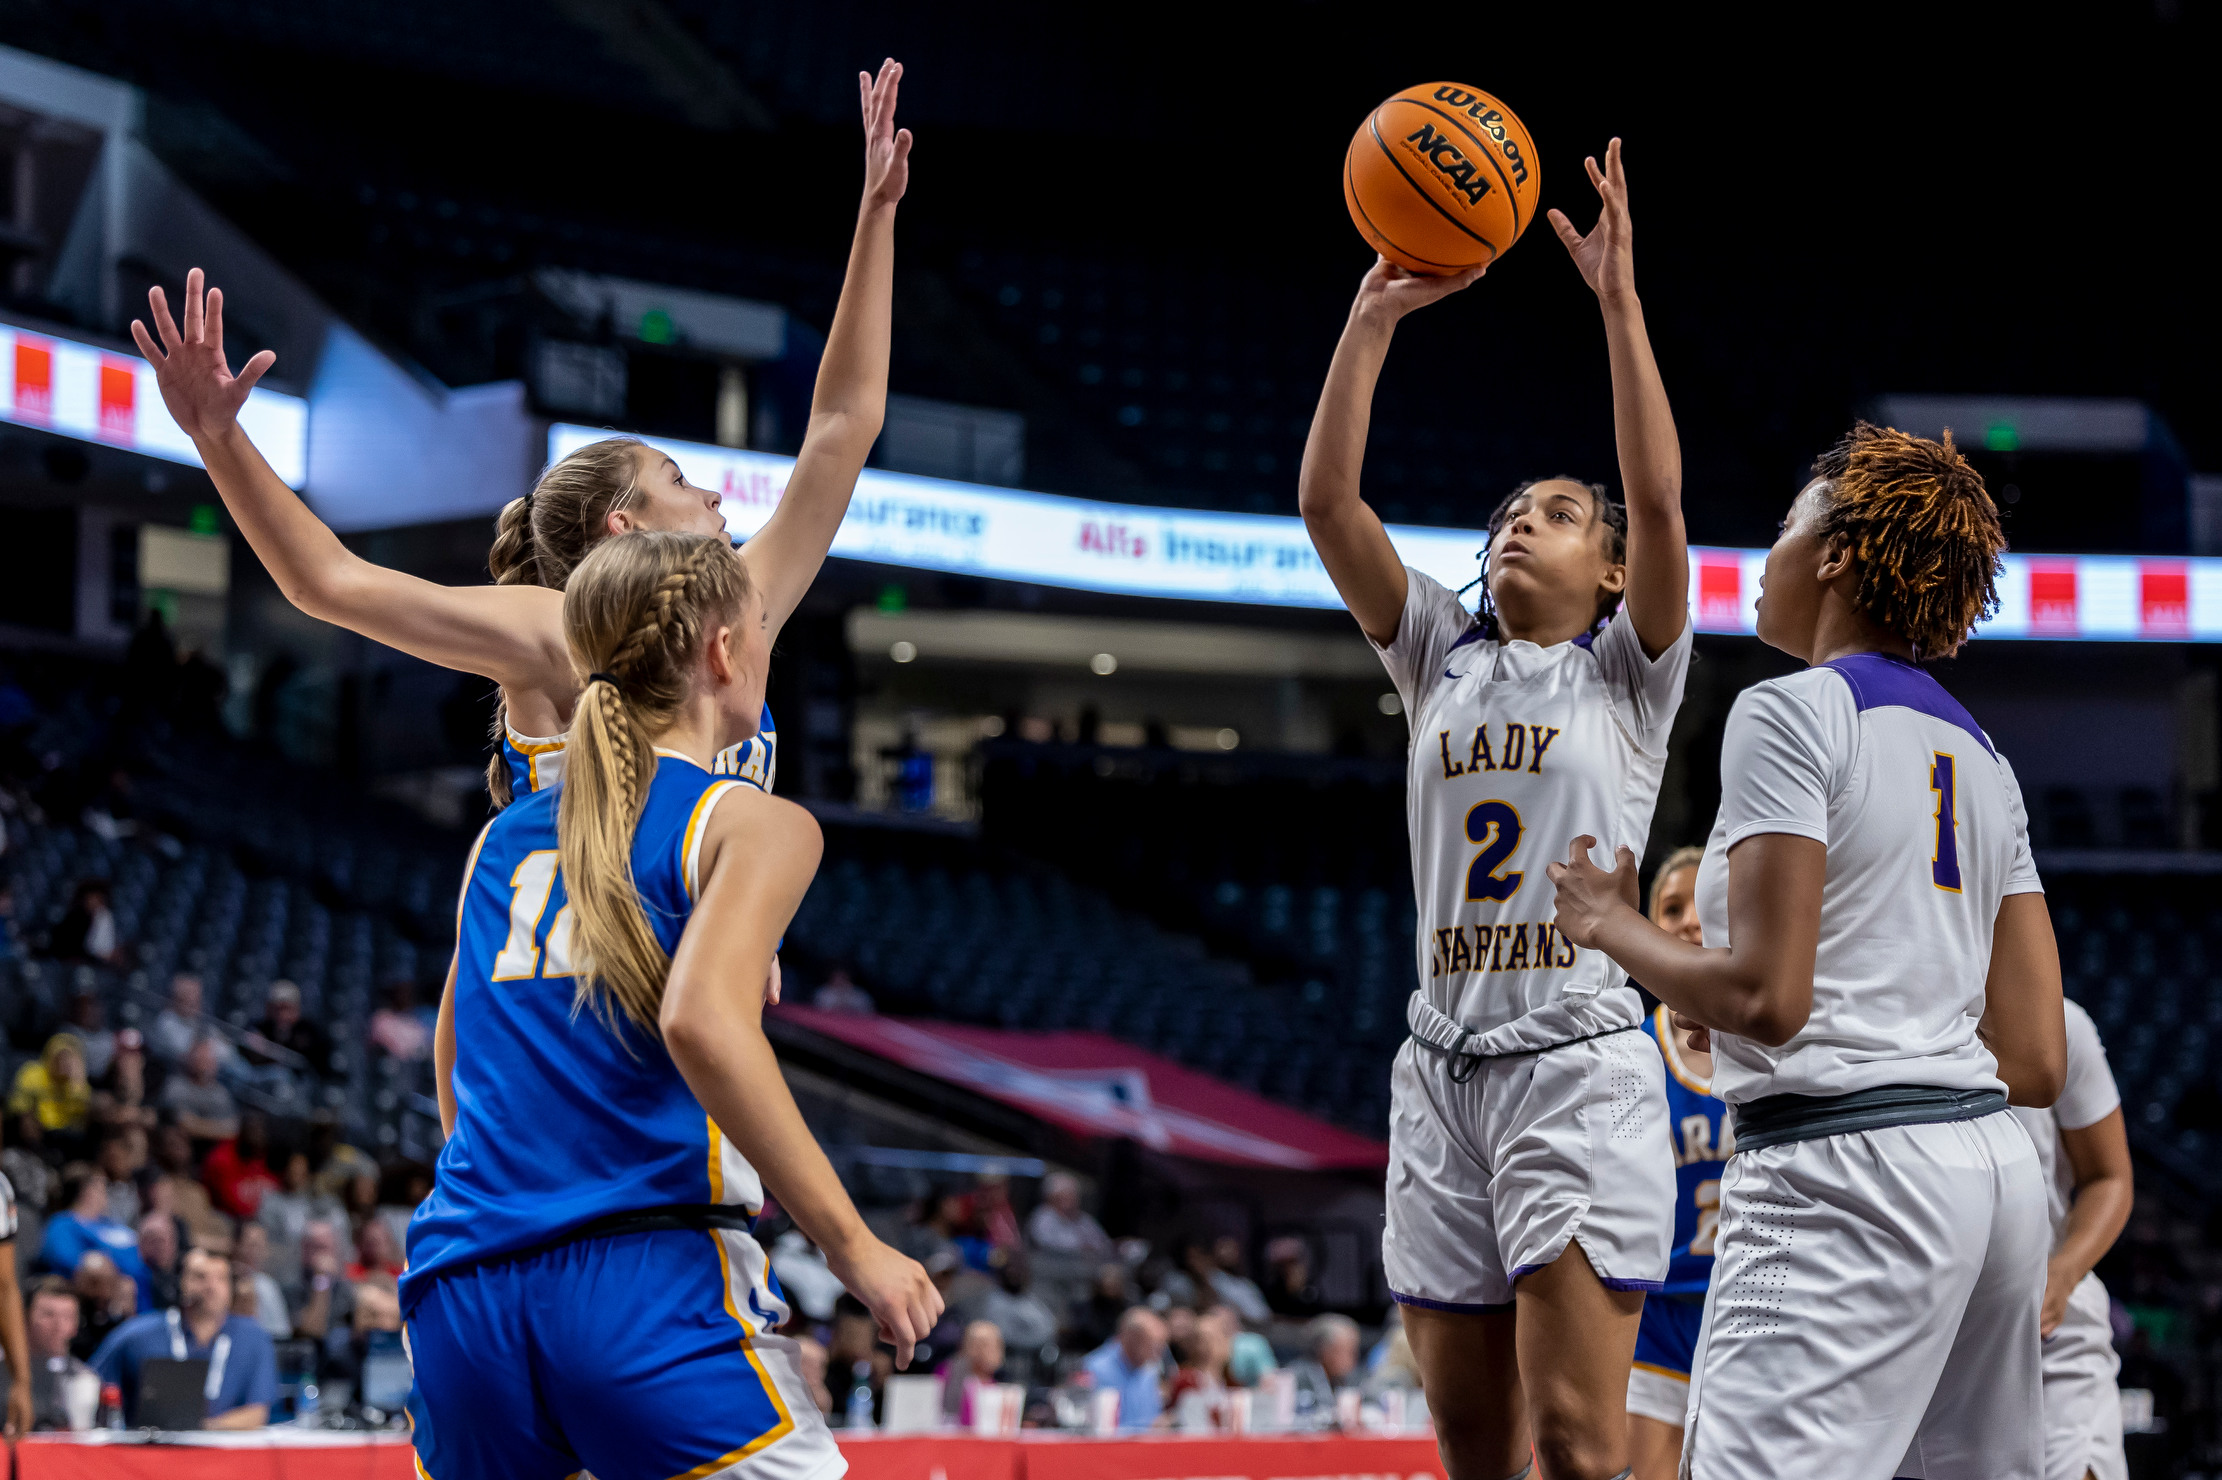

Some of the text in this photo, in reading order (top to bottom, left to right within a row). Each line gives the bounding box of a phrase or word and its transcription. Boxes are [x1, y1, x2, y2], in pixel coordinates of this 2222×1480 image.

[1406, 122, 1493, 206] NCAA
[1162, 528, 1324, 571] Insuran
[1439, 722, 1561, 780] LADY
[1464, 798, 1527, 904] 2
[1930, 750, 1963, 894] 1
